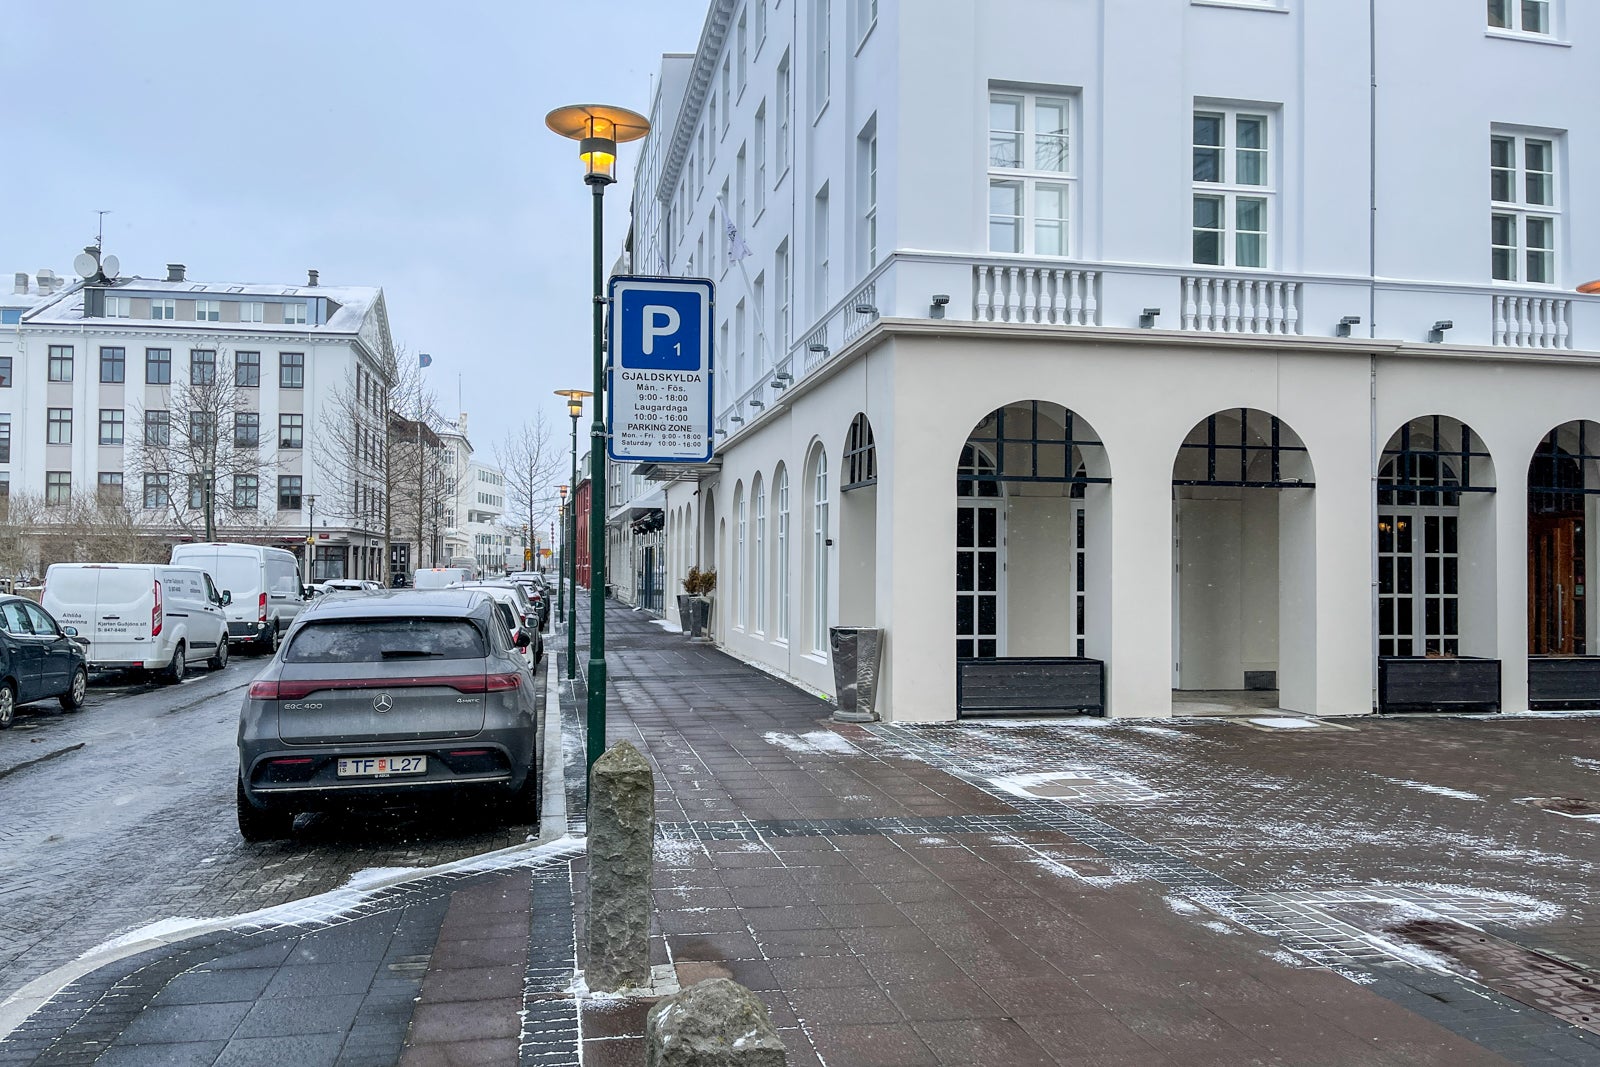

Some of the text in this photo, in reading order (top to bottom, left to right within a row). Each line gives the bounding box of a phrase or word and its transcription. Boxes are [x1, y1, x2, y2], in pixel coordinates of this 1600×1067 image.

[642, 304, 681, 356] P
[673, 342, 681, 357] 1
[621, 371, 702, 383] GJALDSKYLDA
[638, 393, 658, 401] 9:00
[665, 394, 688, 402] 18:00
[634, 403, 688, 413] Laugardaga
[634, 413, 658, 421] 10:00
[665, 414, 688, 422] 16:00
[627, 423, 692, 432] PARKING ZONE
[352, 759, 375, 773] TF
[390, 757, 422, 772] L27
